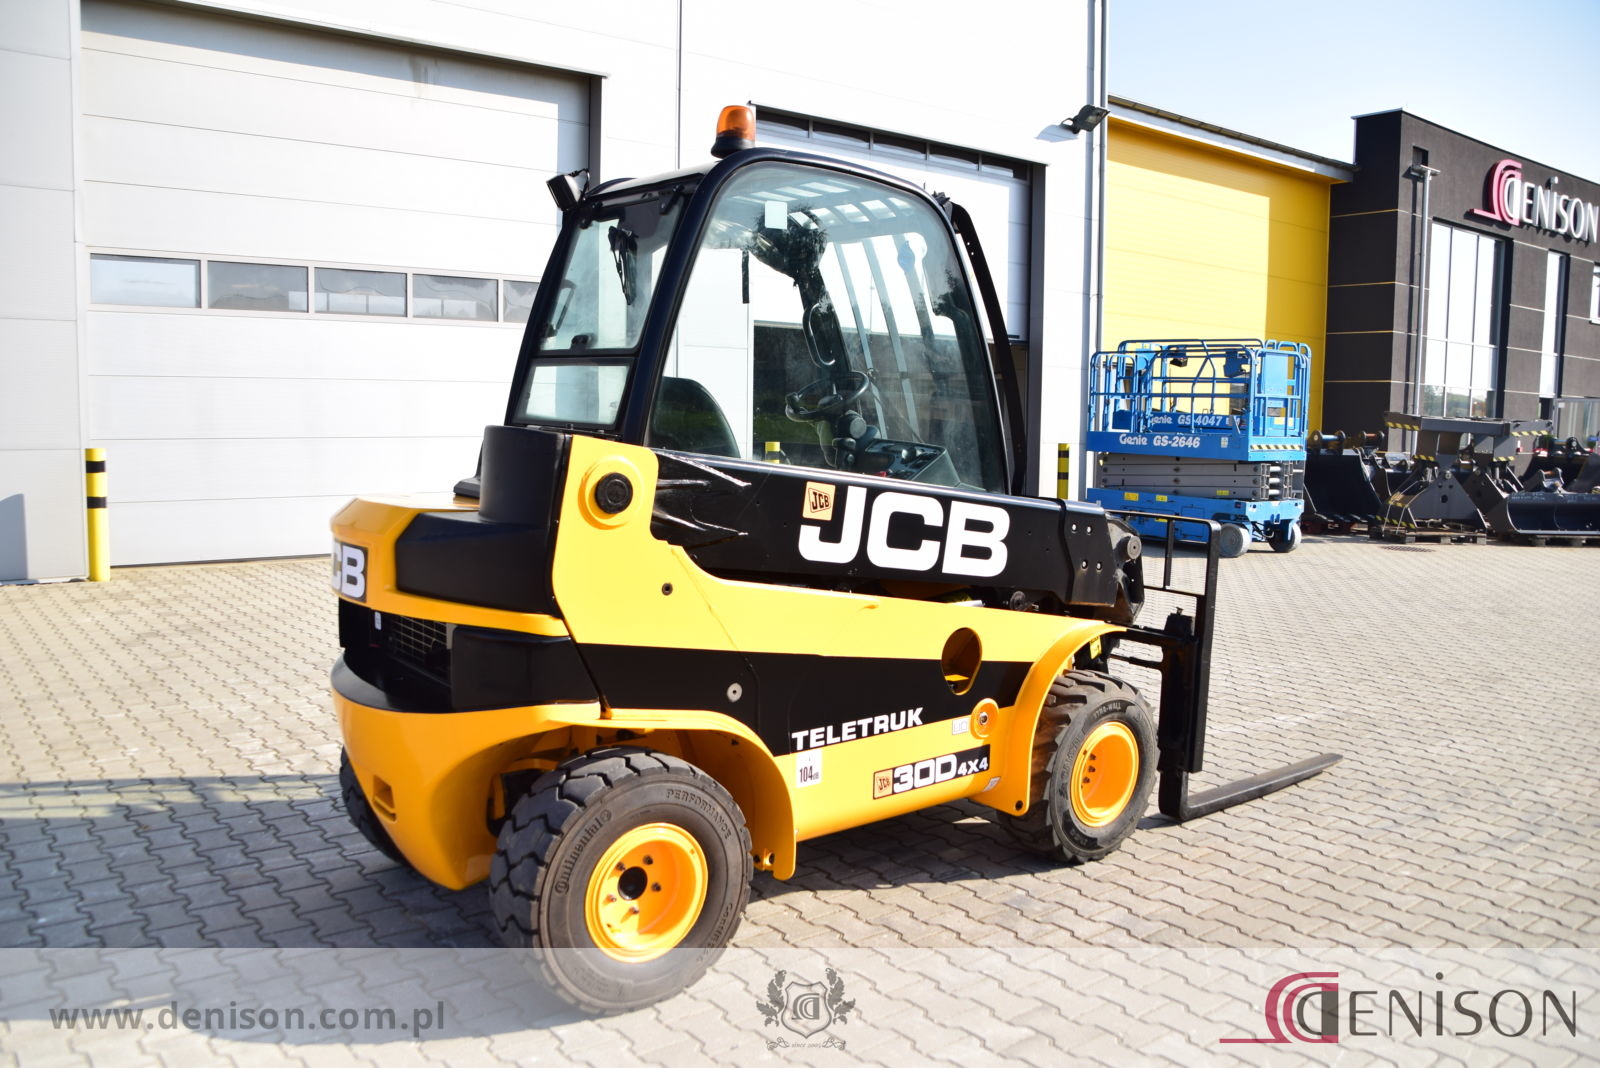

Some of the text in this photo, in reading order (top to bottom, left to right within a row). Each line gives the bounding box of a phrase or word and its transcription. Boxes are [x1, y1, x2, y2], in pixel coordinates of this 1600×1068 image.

[1119, 433, 1201, 449] Genie GS-2646
[811, 491, 830, 511] JCB
[798, 485, 1010, 578] JCB
[791, 707, 924, 750] TELETRUK
[893, 753, 957, 793] 30D
[666, 788, 732, 840] PERFORMANCE
